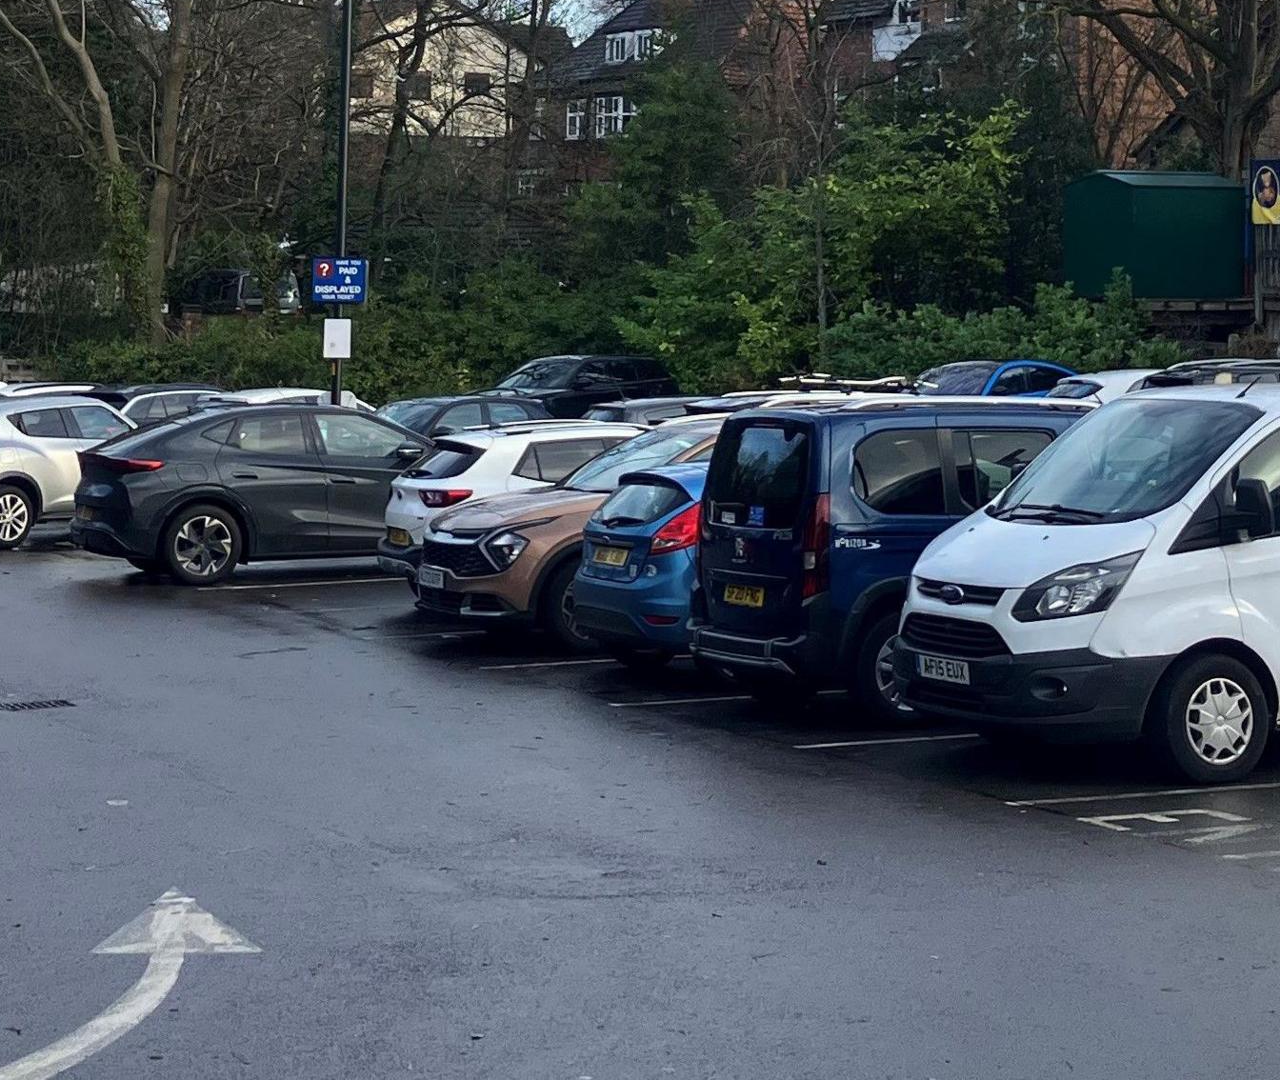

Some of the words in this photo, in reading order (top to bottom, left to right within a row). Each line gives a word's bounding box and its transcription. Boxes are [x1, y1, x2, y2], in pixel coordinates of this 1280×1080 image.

[338, 266, 359, 275] PAID
[344, 276, 352, 284] &
[314, 285, 362, 294] DISPLAYED
[945, 660, 967, 681] EUX
